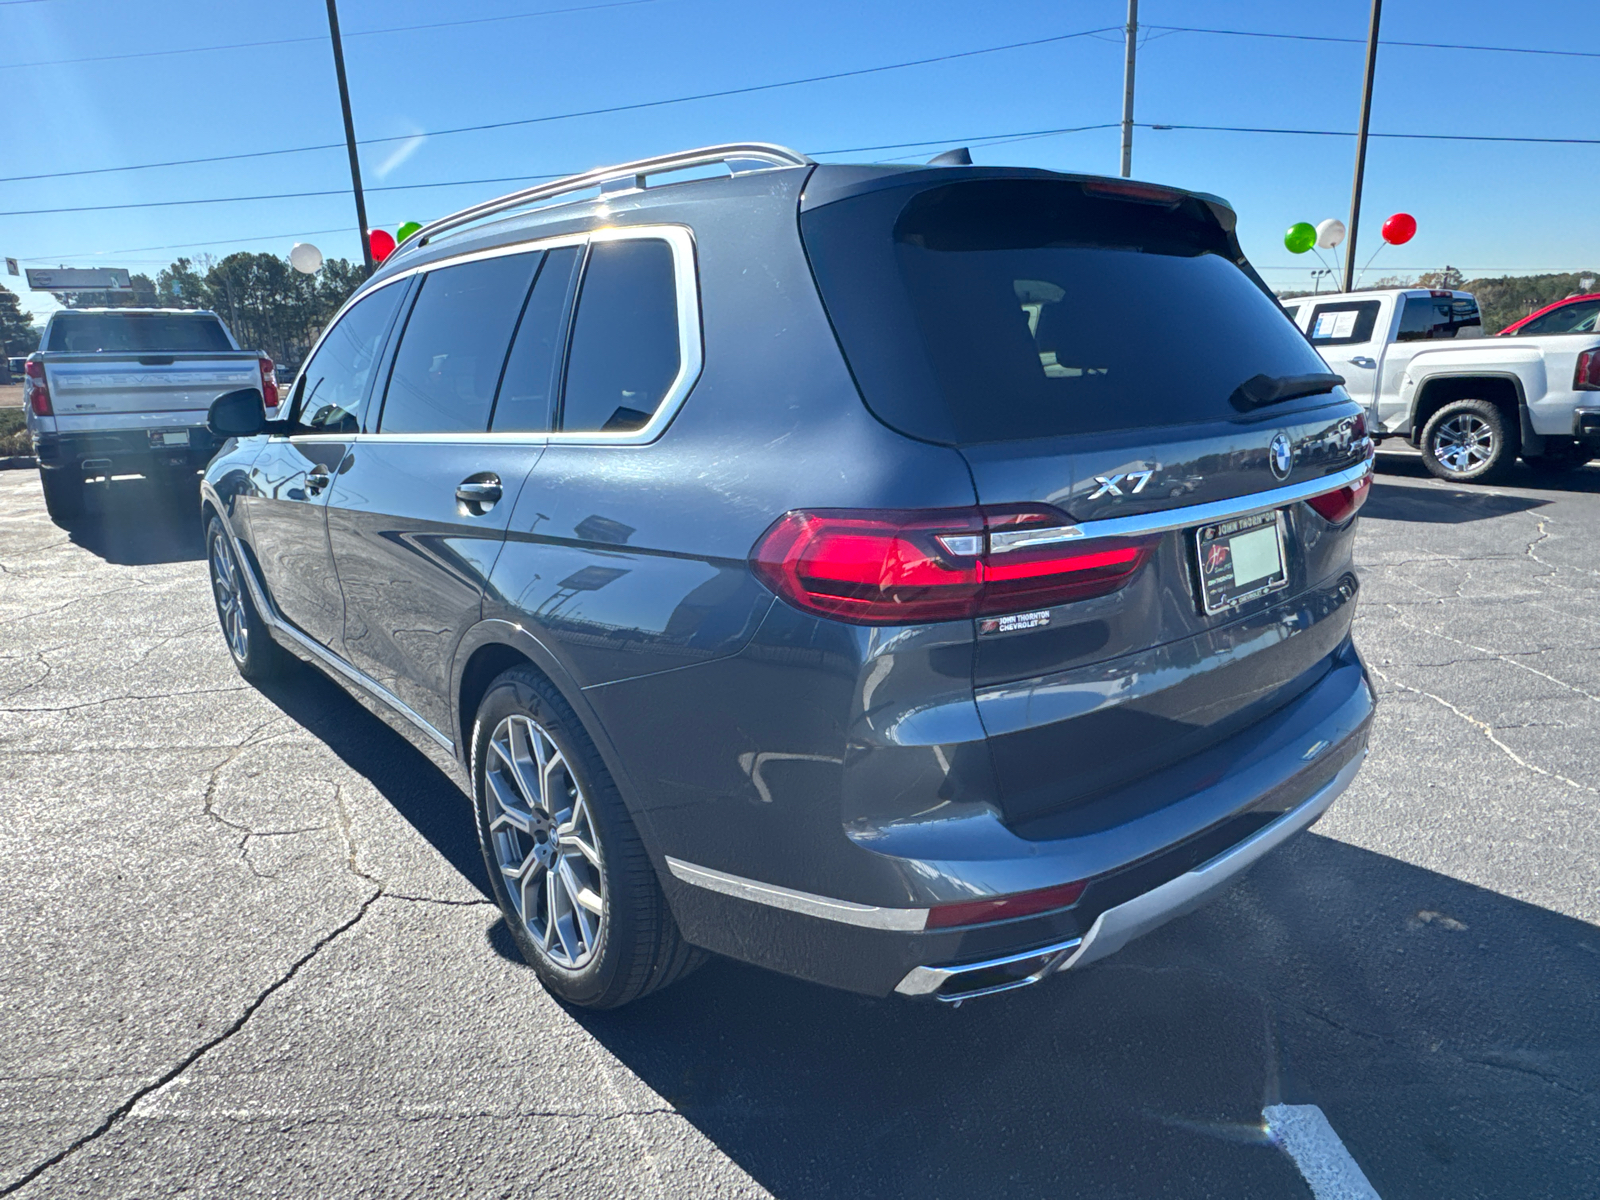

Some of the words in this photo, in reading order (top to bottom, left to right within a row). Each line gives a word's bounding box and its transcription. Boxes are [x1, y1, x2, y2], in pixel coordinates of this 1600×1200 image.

[1087, 469, 1154, 500] X7
[1218, 521, 1238, 536] JOHN
[1239, 511, 1276, 529] THORNTON
[999, 615, 1017, 625] JOHN
[1017, 610, 1050, 621] THORNTON
[999, 620, 1039, 631] CHEVROLET
